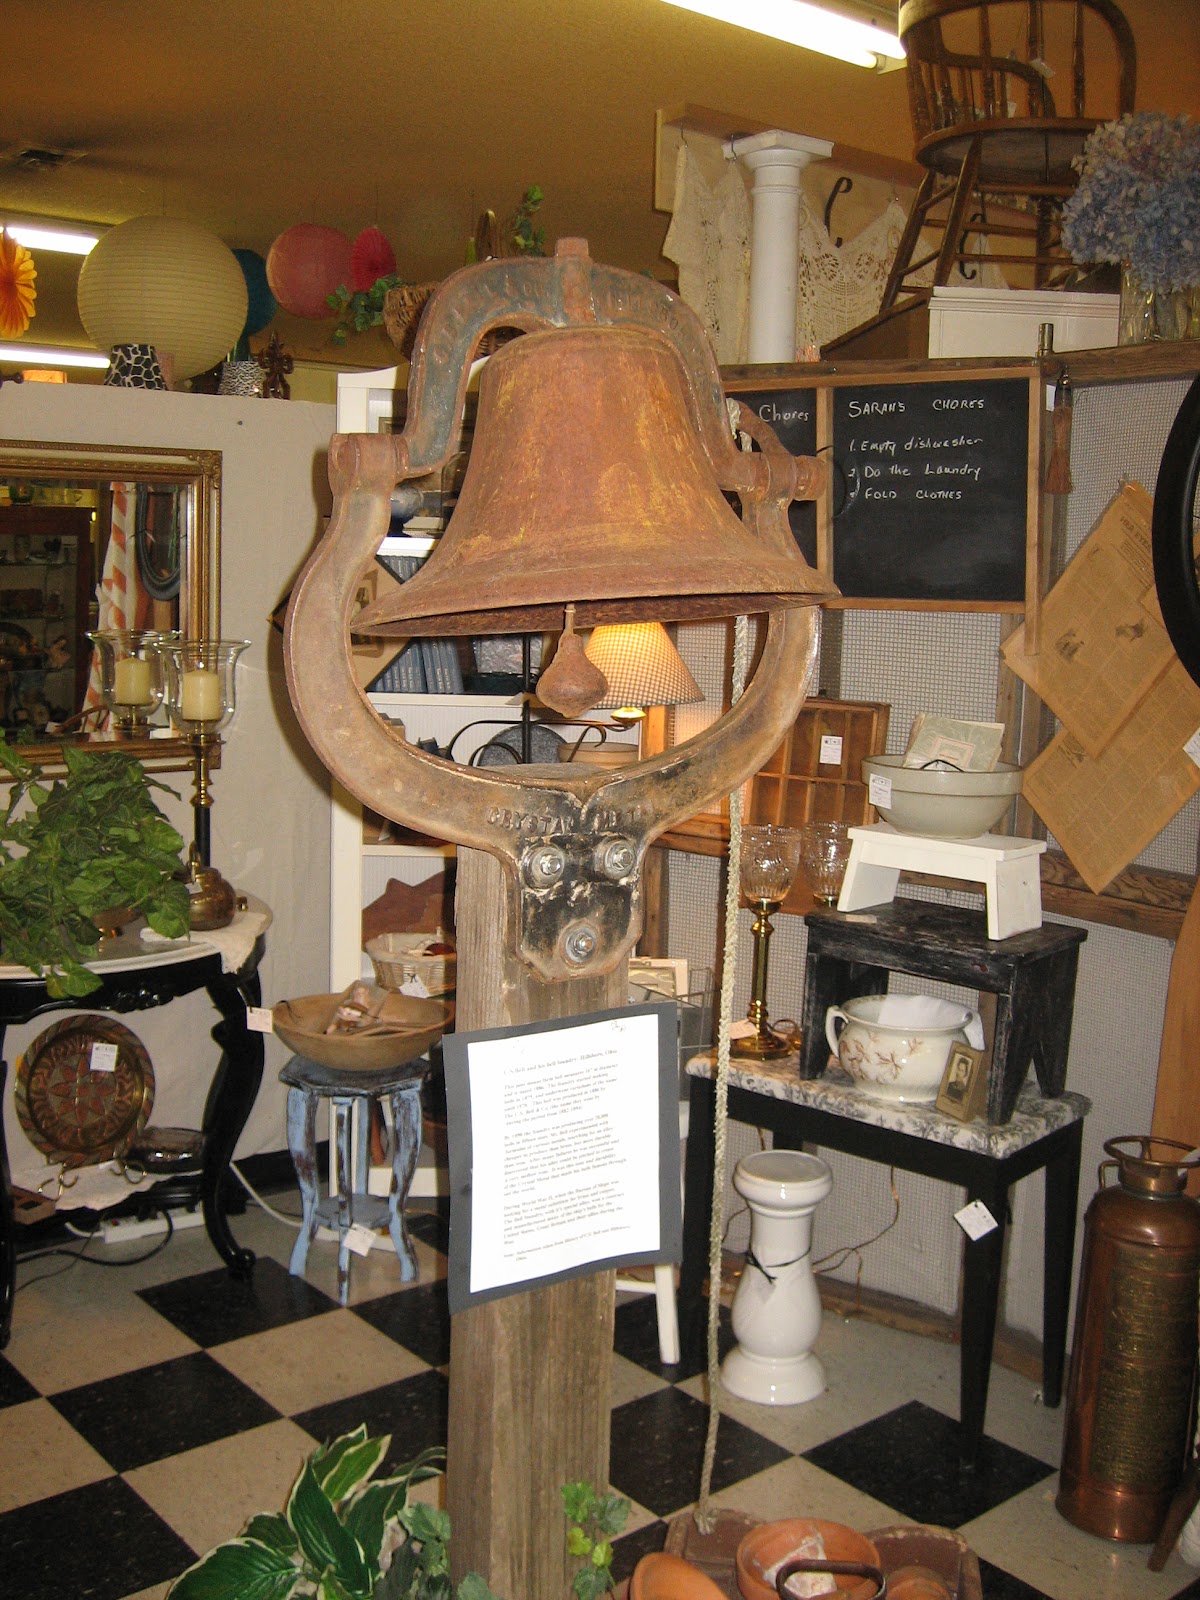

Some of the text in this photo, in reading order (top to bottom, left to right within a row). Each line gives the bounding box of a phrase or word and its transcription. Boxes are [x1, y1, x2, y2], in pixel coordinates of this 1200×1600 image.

[759, 403, 809, 422] Chores
[932, 398, 985, 411] CHORES
[861, 440, 897, 457] Empty
[864, 465, 881, 478] Do
[889, 464, 911, 477] the
[924, 463, 981, 481] Laundry
[865, 488, 897, 500] FOLD
[915, 489, 962, 500] CLOTHES
